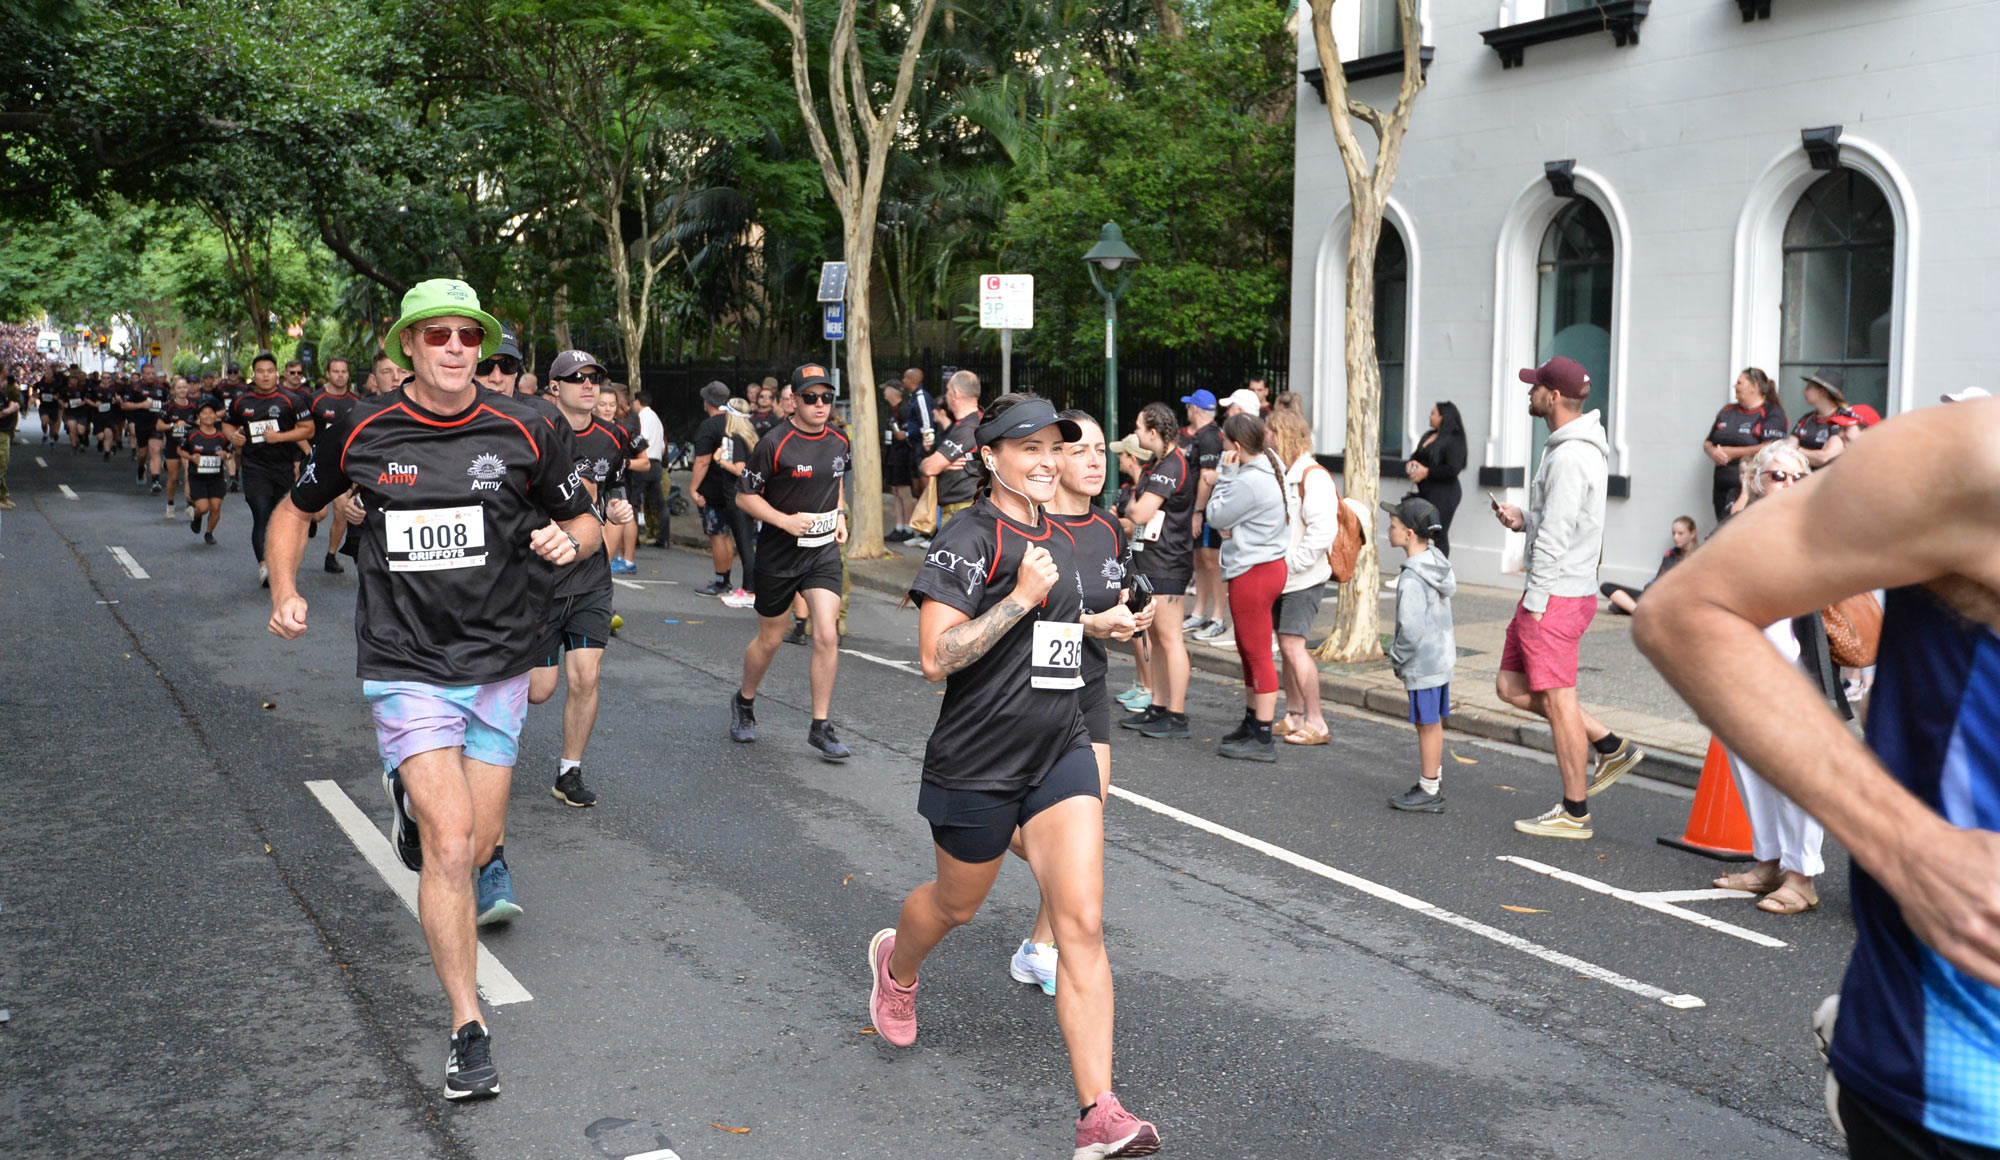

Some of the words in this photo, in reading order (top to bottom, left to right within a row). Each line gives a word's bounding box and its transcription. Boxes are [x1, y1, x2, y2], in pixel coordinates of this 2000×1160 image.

[827, 305, 840, 317] PAY
[984, 302, 1004, 315] 3P
[826, 322, 843, 334] HERE
[388, 462, 418, 475] Run
[797, 464, 812, 473] Run
[377, 472, 418, 487] Army
[471, 480, 503, 491] Army
[403, 523, 468, 550] 1008
[408, 548, 465, 561] GRIFFO75
[1106, 580, 1121, 590] Arm
